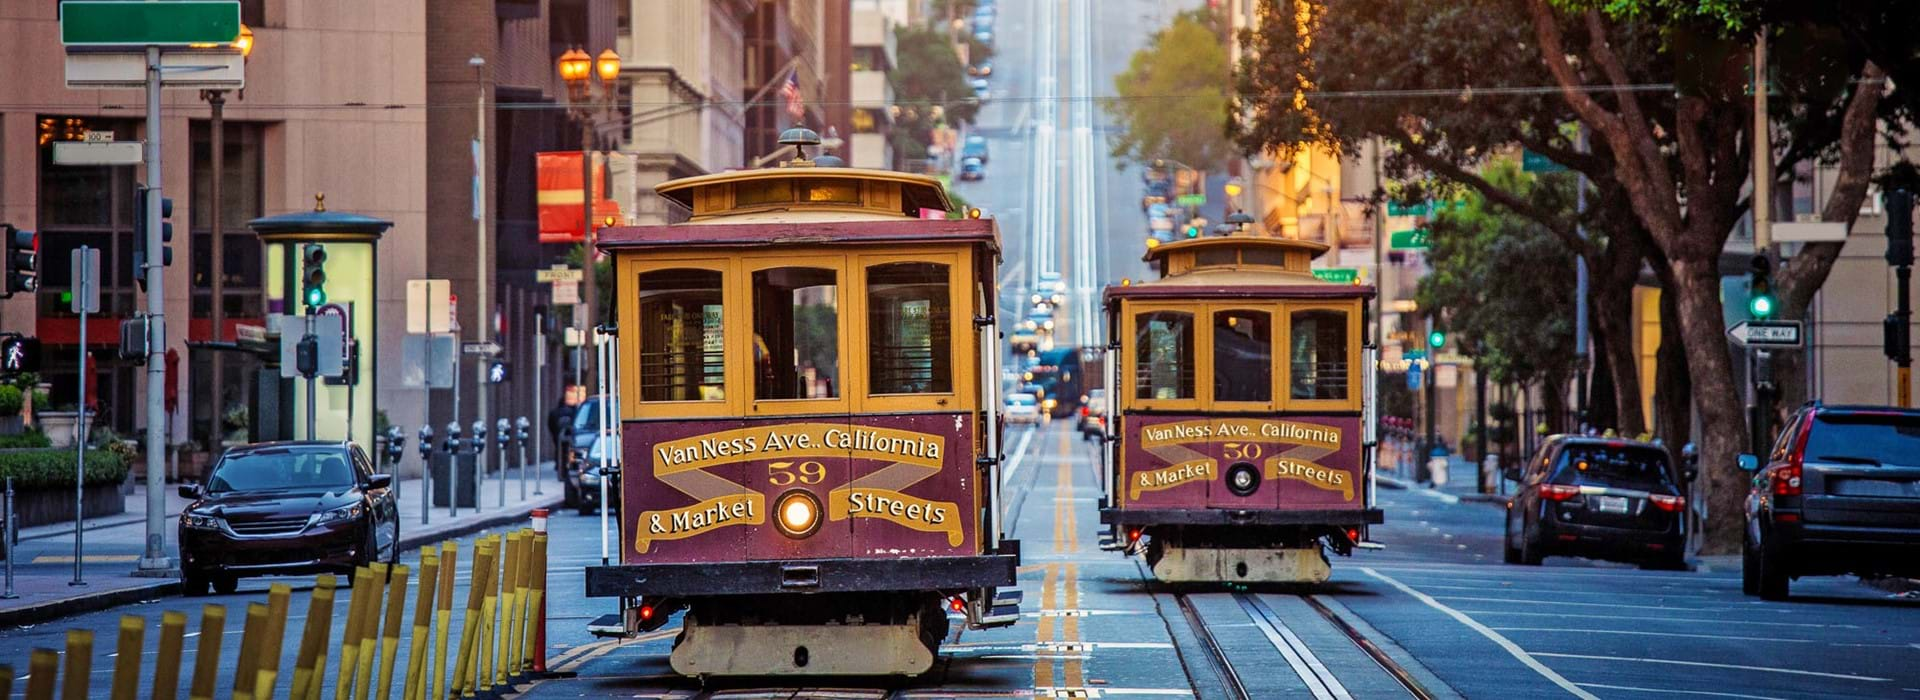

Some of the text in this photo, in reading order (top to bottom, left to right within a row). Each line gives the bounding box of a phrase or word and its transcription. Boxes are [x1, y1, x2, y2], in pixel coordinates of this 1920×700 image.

[544, 271, 575, 279] FRONT
[1748, 327, 1793, 337] ONE WAY
[1146, 429, 1172, 441] Van
[1175, 424, 1212, 438] Ness
[1261, 423, 1339, 443] California
[659, 446, 698, 466] Van
[700, 438, 757, 459] Ness
[824, 429, 940, 459] California
[1224, 443, 1262, 459] 50
[768, 461, 827, 485] 59
[1140, 462, 1210, 486] & Market
[1278, 461, 1344, 485] Streets
[650, 499, 754, 534] & Market
[848, 492, 946, 525] Streets
